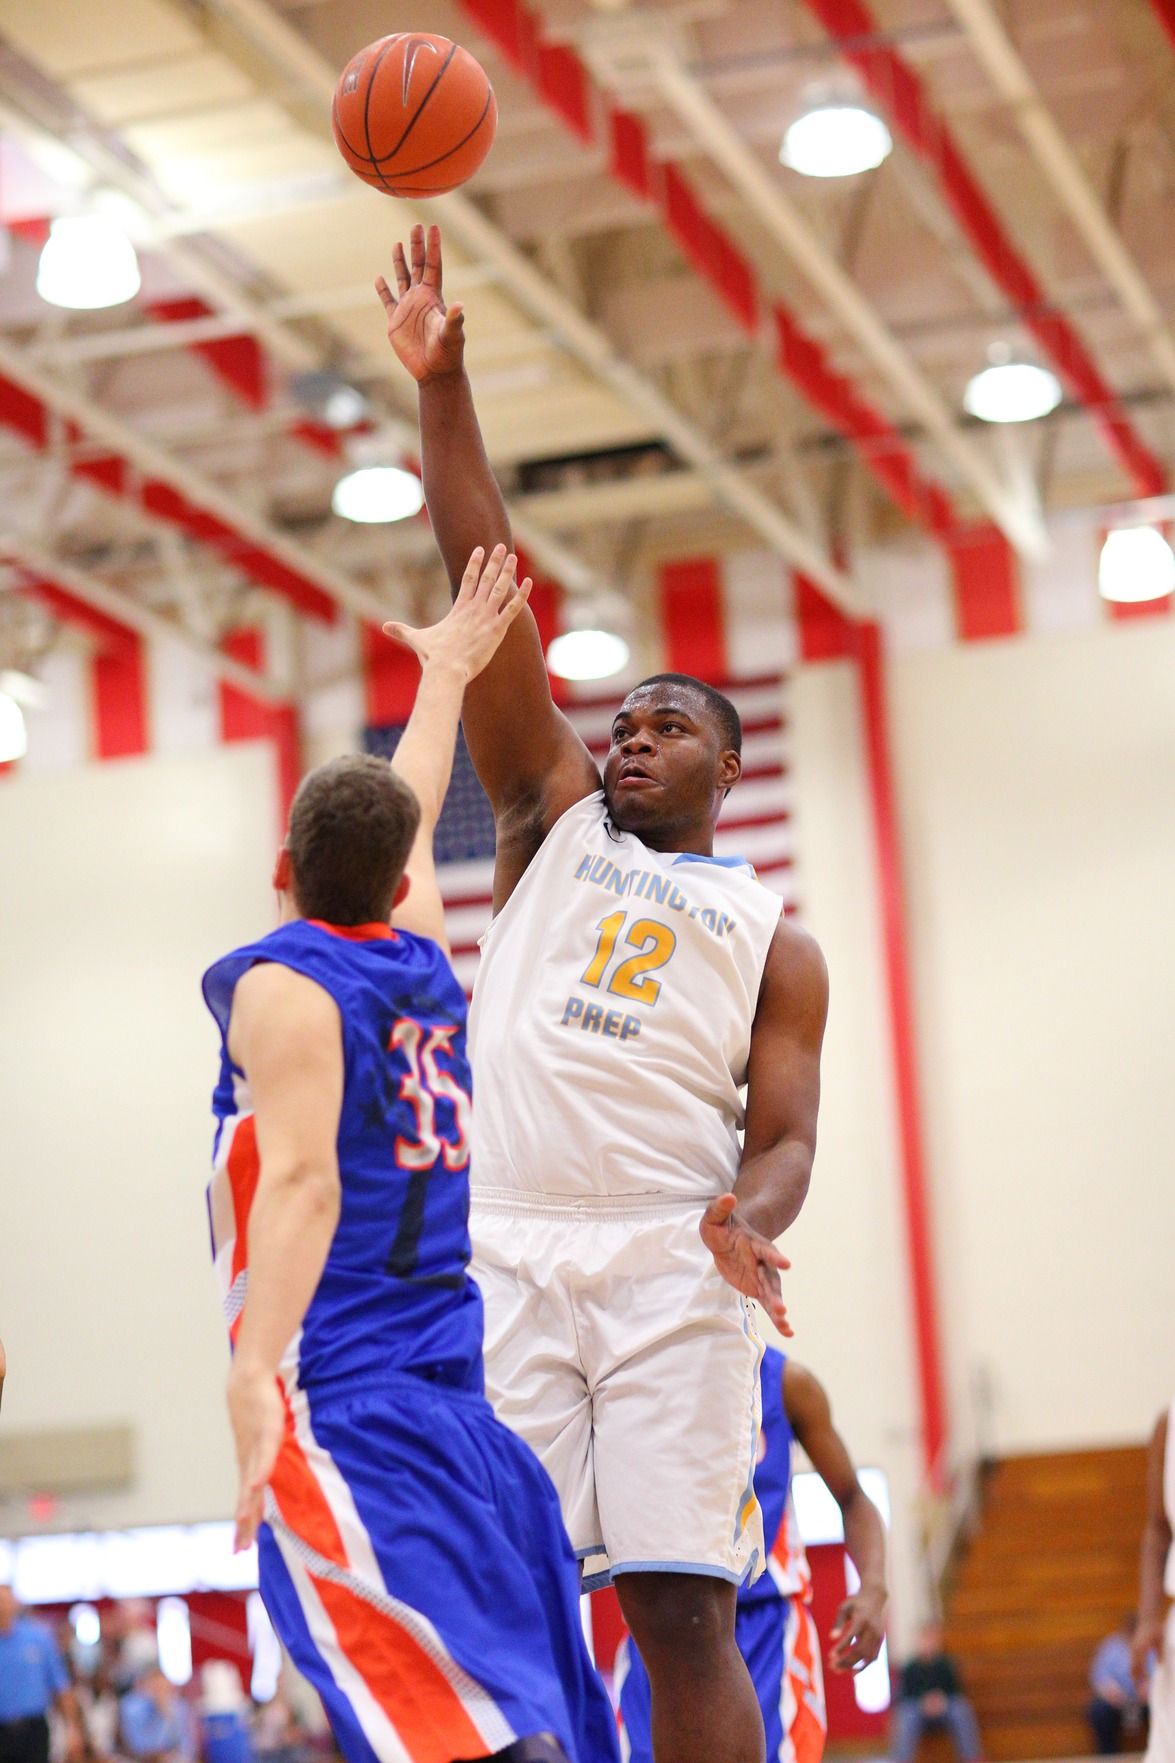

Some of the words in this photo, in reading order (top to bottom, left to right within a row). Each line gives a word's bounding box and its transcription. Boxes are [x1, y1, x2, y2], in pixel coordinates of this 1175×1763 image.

[580, 910, 677, 1007] 12
[560, 996, 641, 1041] PREP
[387, 1016, 473, 1172] 35
